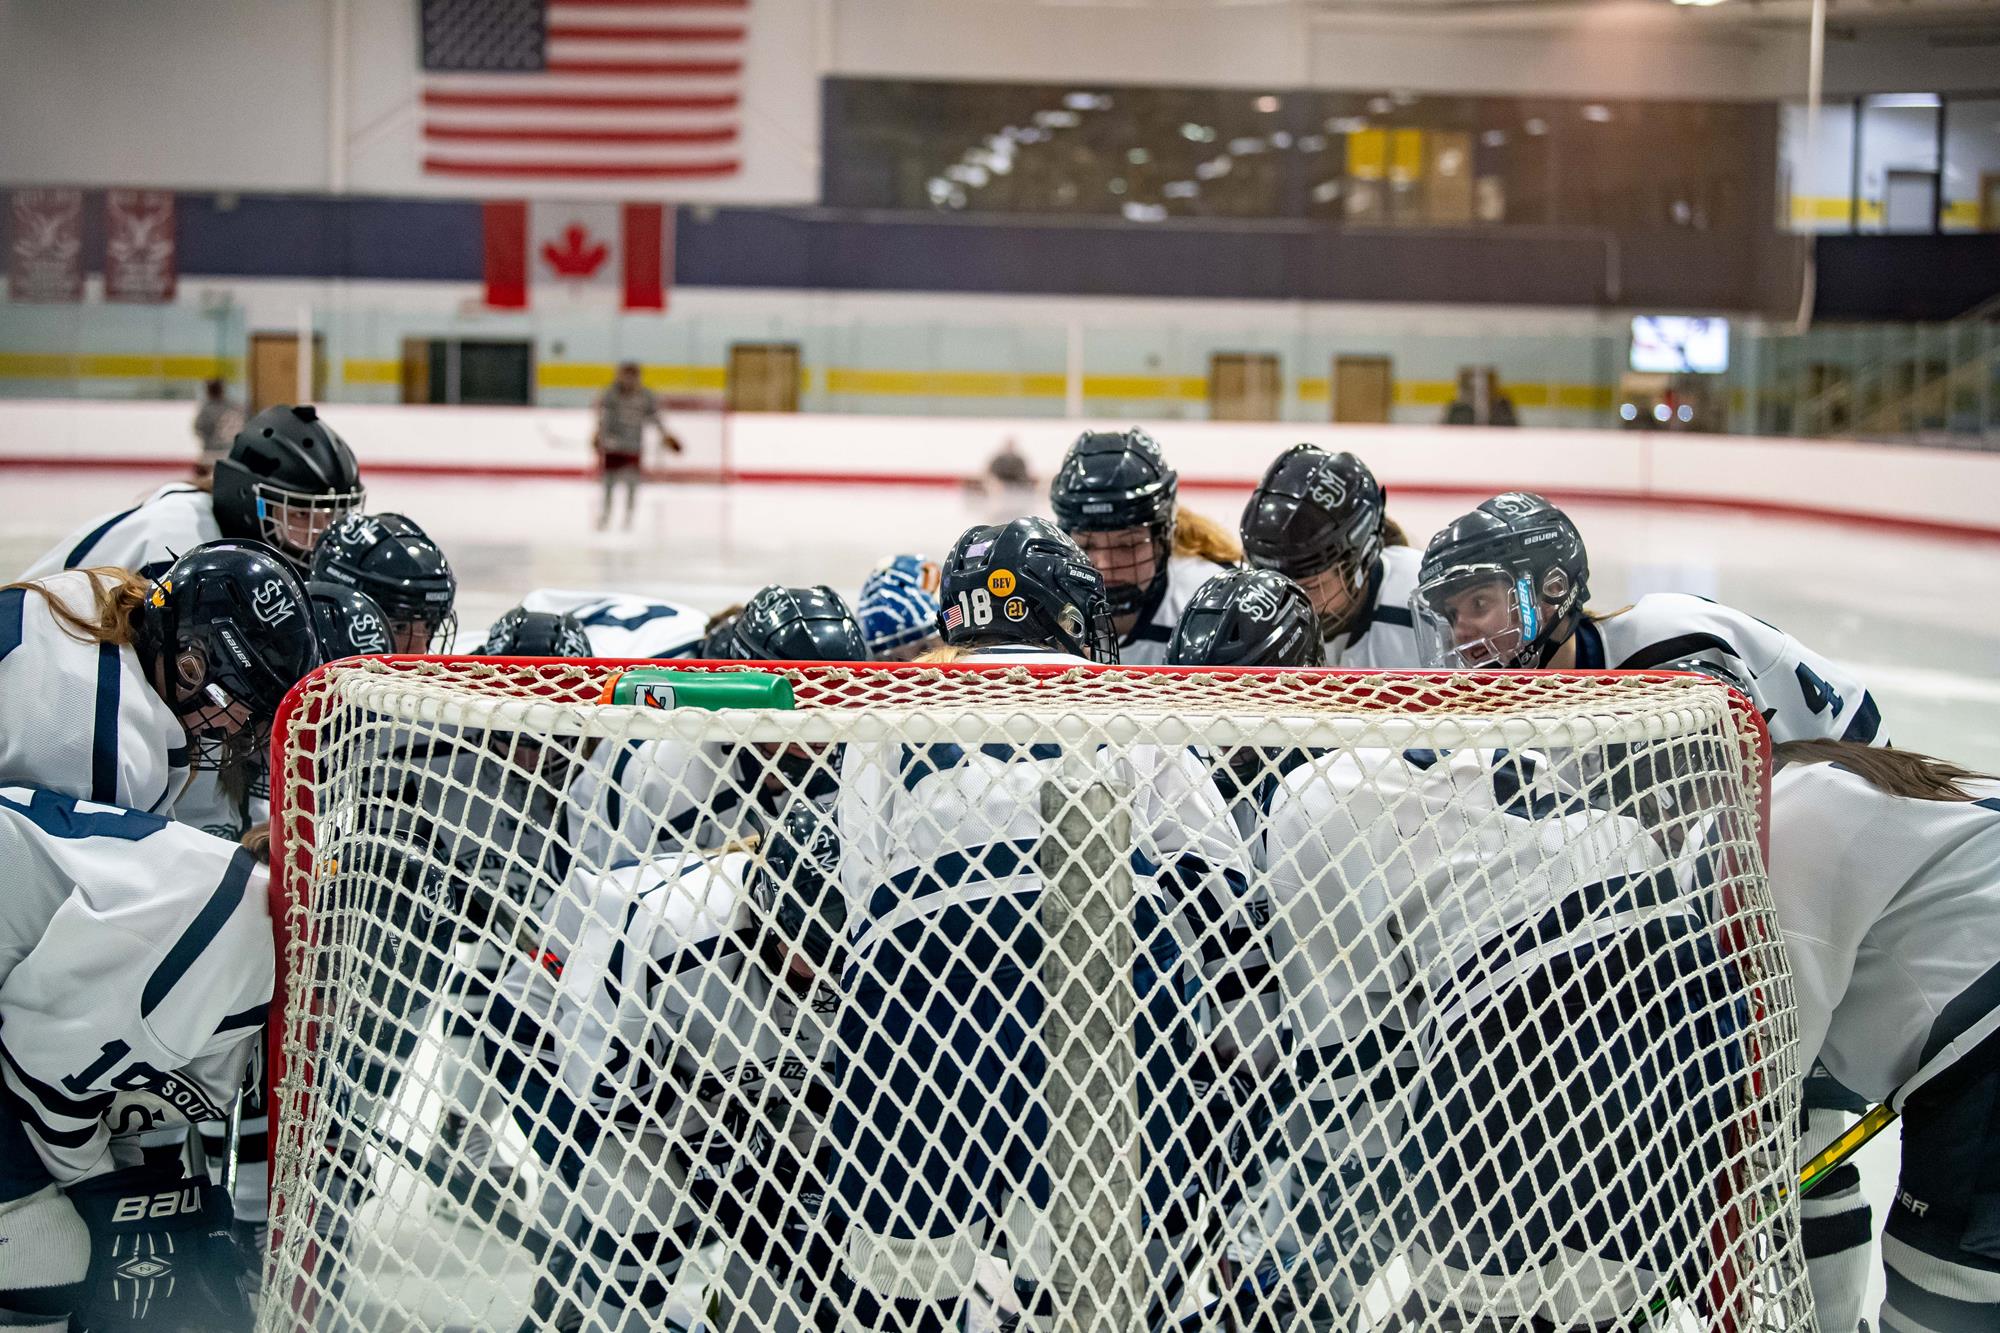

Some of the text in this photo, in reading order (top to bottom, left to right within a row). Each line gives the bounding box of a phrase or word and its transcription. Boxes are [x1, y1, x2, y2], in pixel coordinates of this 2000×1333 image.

[1524, 531, 1558, 545] BAUER
[992, 577, 1011, 589] BEV
[1069, 569, 1096, 583] BAUER
[959, 588, 993, 628] 18
[1008, 601, 1024, 617] 21
[1517, 580, 1531, 638] BAUER
[221, 630, 252, 668] BAUER
[1795, 661, 1844, 719] 4
